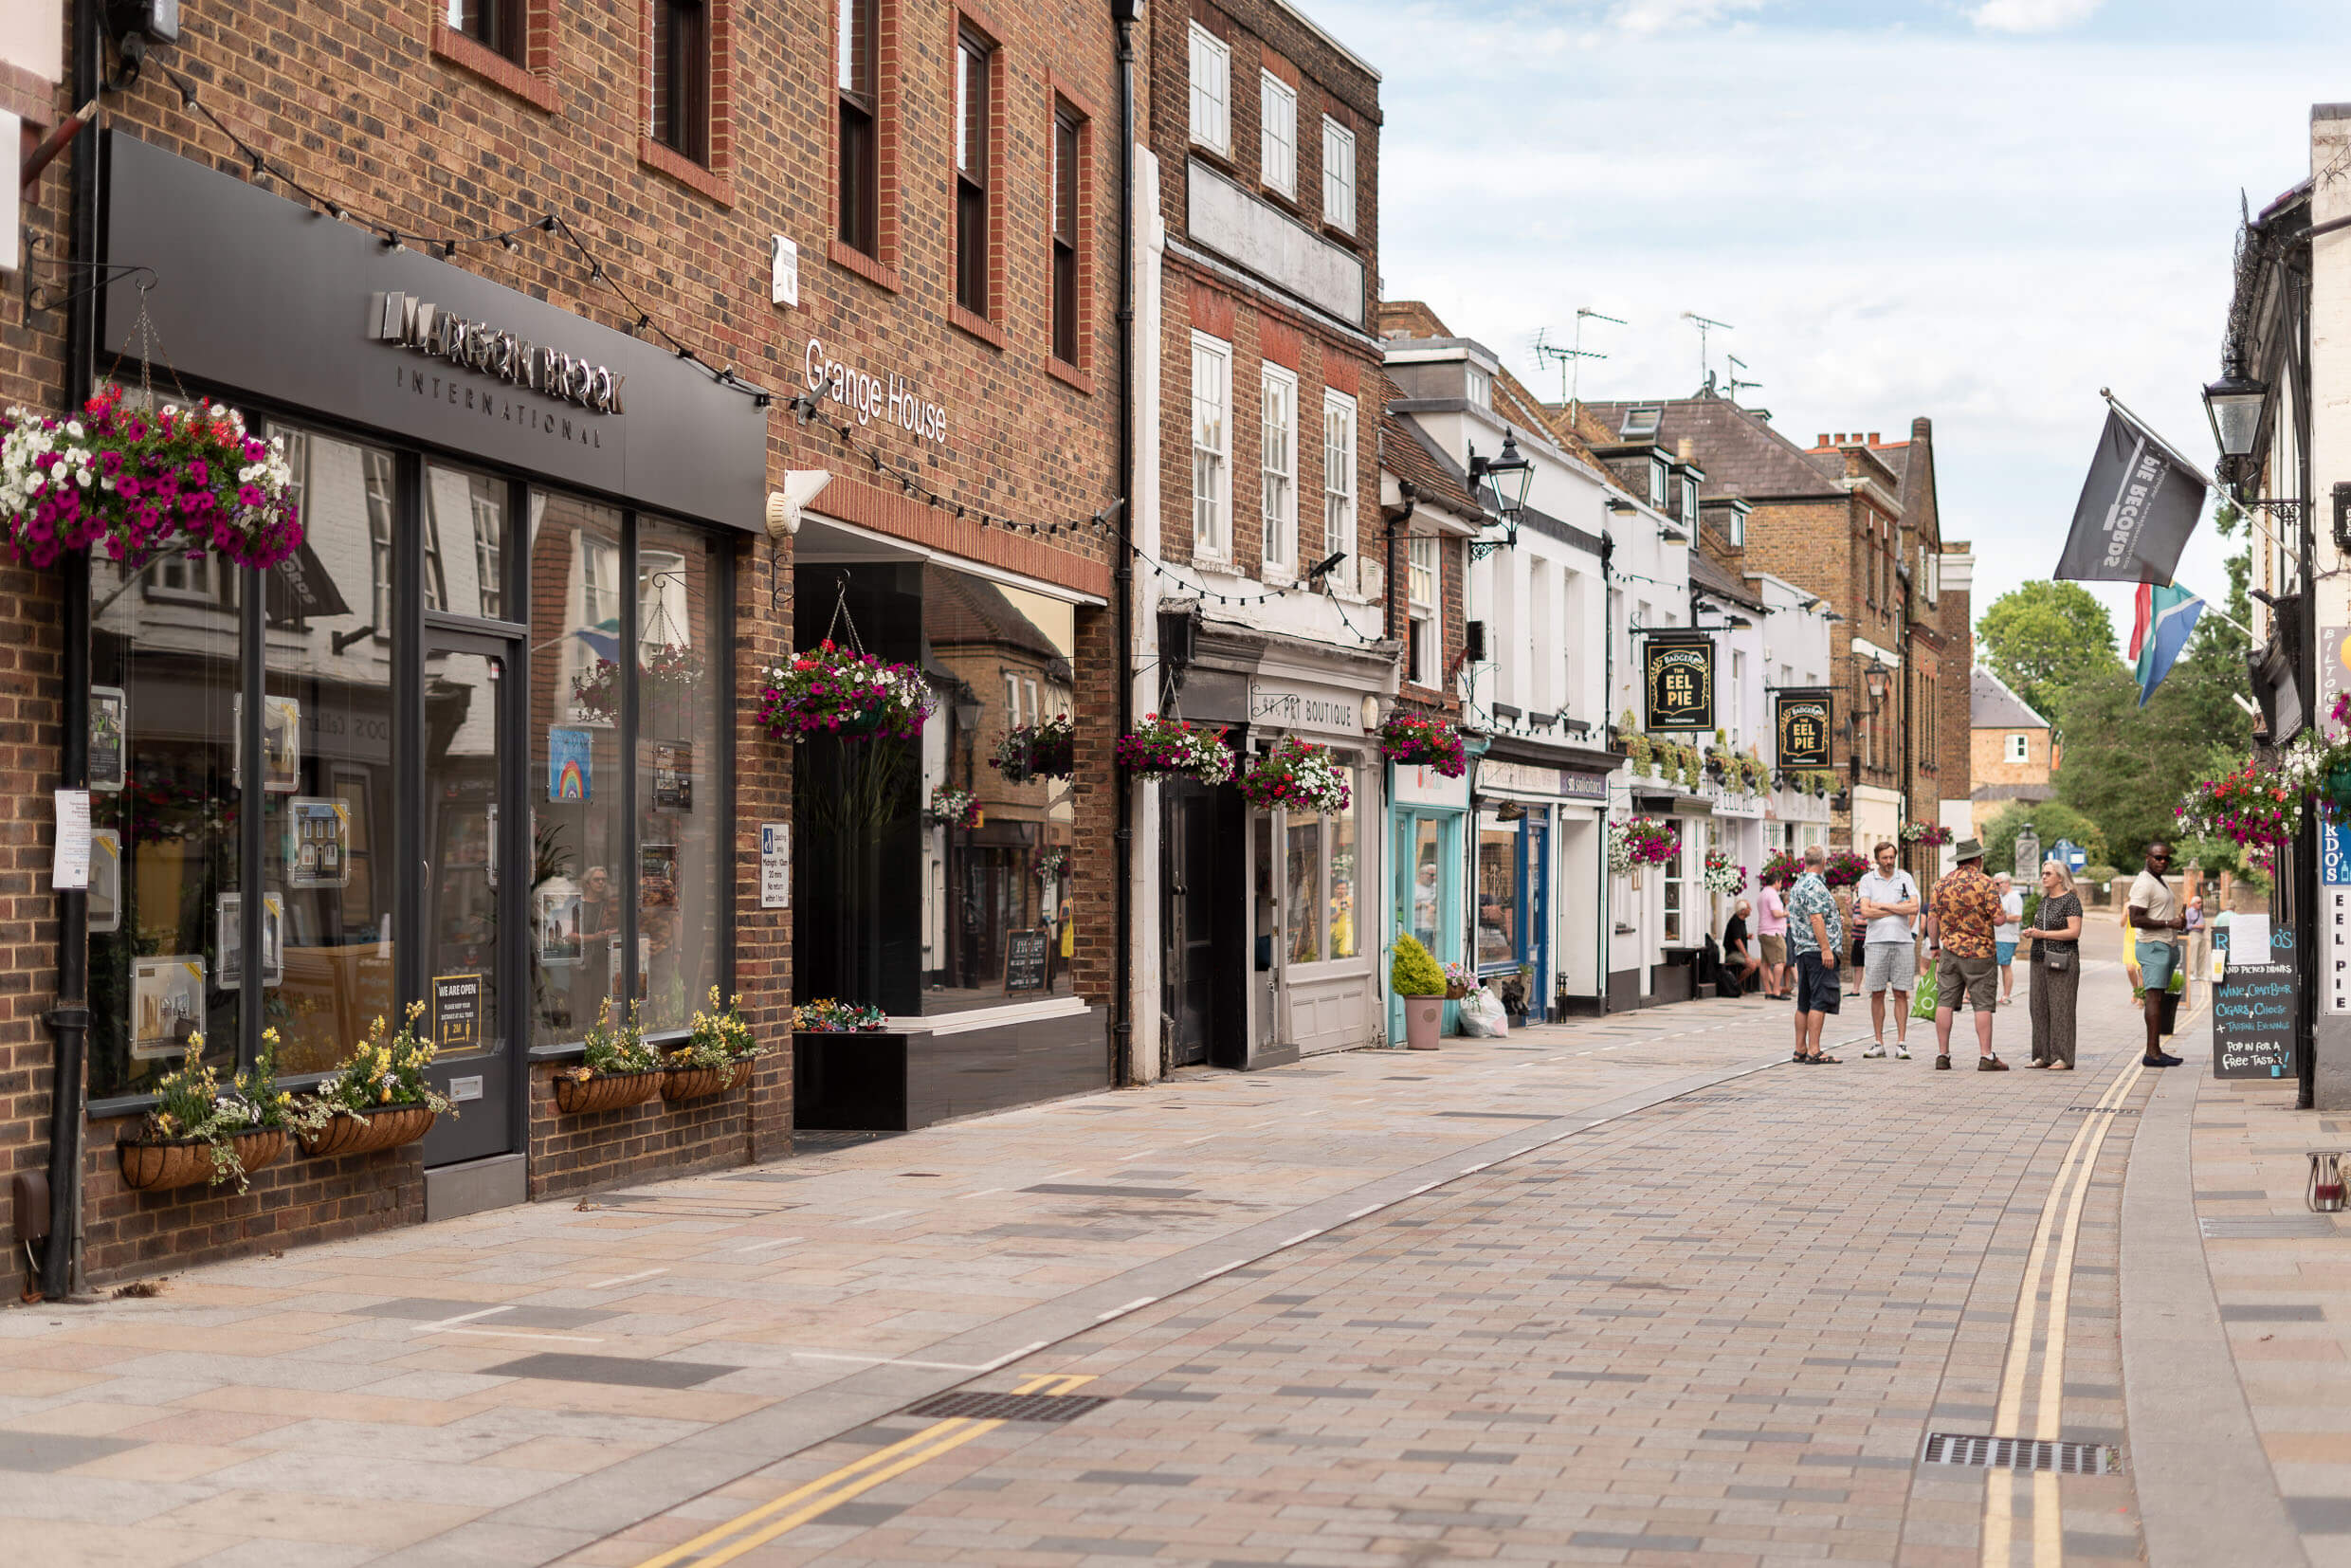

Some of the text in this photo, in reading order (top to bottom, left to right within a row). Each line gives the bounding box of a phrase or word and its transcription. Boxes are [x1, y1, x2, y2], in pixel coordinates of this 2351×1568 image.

[382, 291, 626, 416] MADISON BROOK
[806, 338, 946, 444] Grange House
[395, 365, 601, 448] INTERNATIONAL
[1666, 674, 1694, 690] EEL
[1667, 690, 1693, 706] PIE
[1305, 700, 1351, 727] BOUTIQUE
[1793, 722, 1816, 737] EEL
[1794, 736, 1815, 750] PIE
[2335, 894, 2346, 1009] EEL PIE
[439, 983, 476, 997] WE ARE OPEN
[2226, 1040, 2281, 1052] POP IN FOR A
